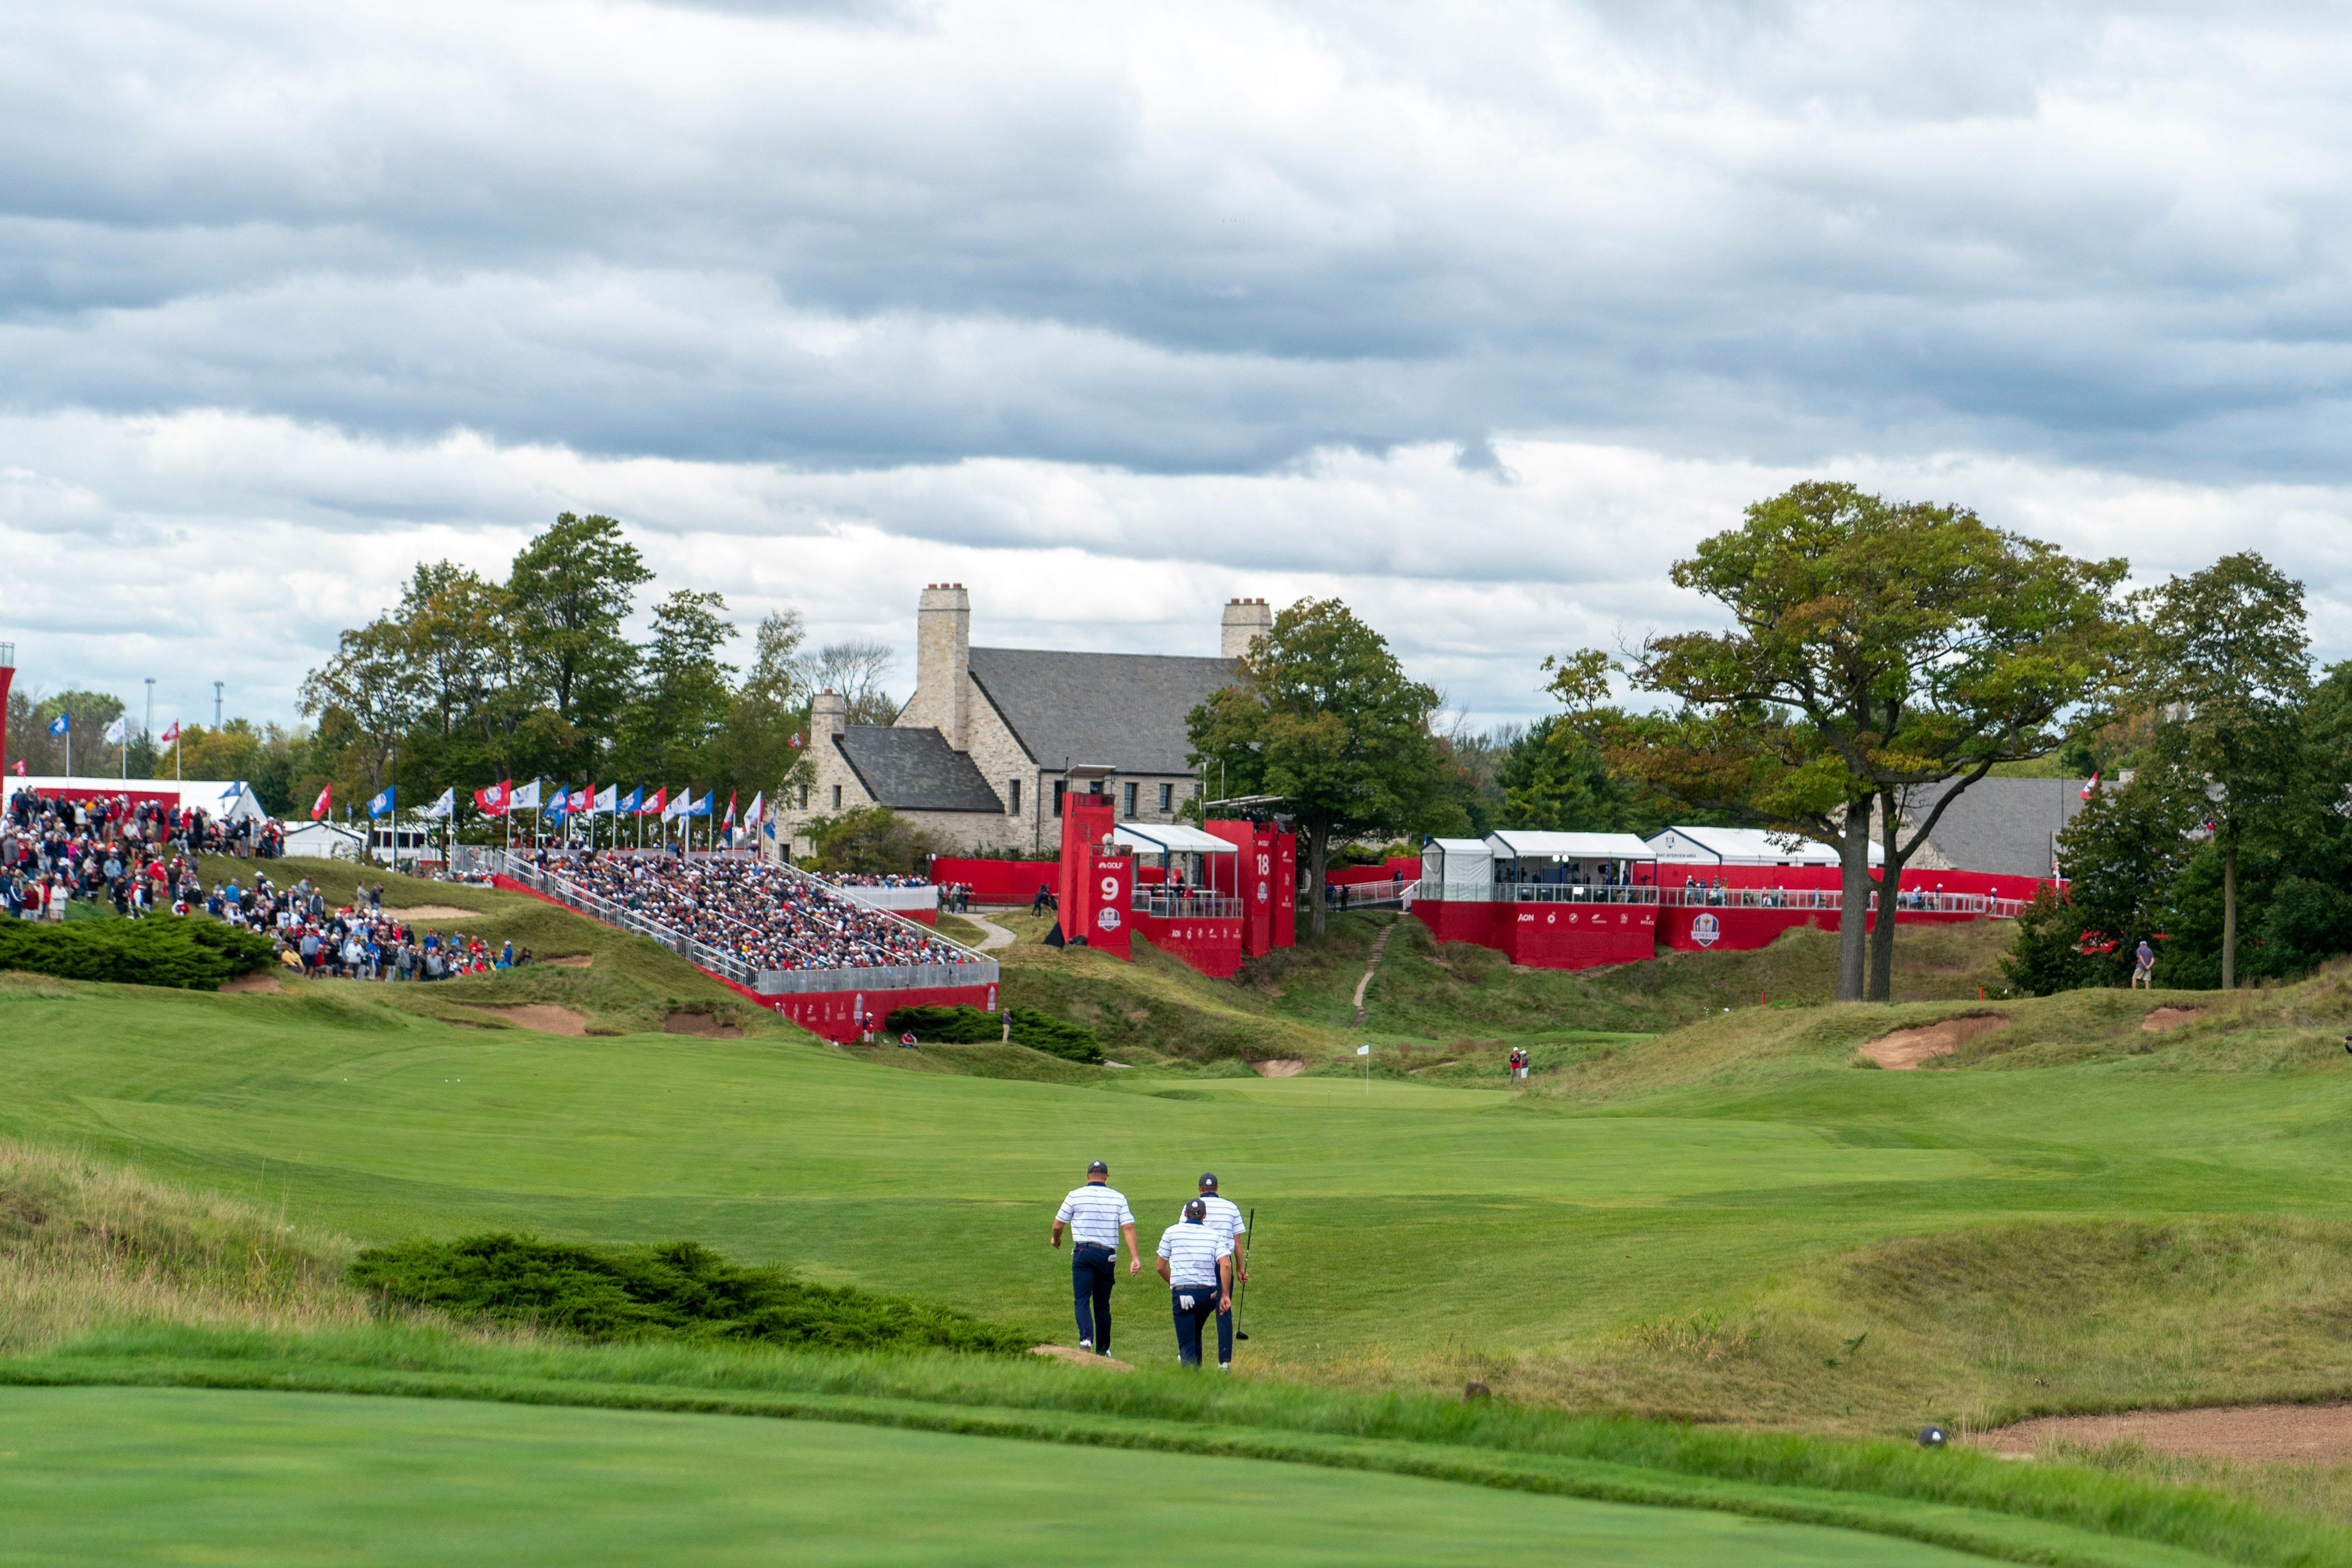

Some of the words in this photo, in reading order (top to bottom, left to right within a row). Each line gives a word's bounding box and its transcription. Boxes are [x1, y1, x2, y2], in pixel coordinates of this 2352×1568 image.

[1257, 853, 1269, 875] 18
[1101, 877, 1119, 900] 9
[1518, 913, 1534, 922] AON
